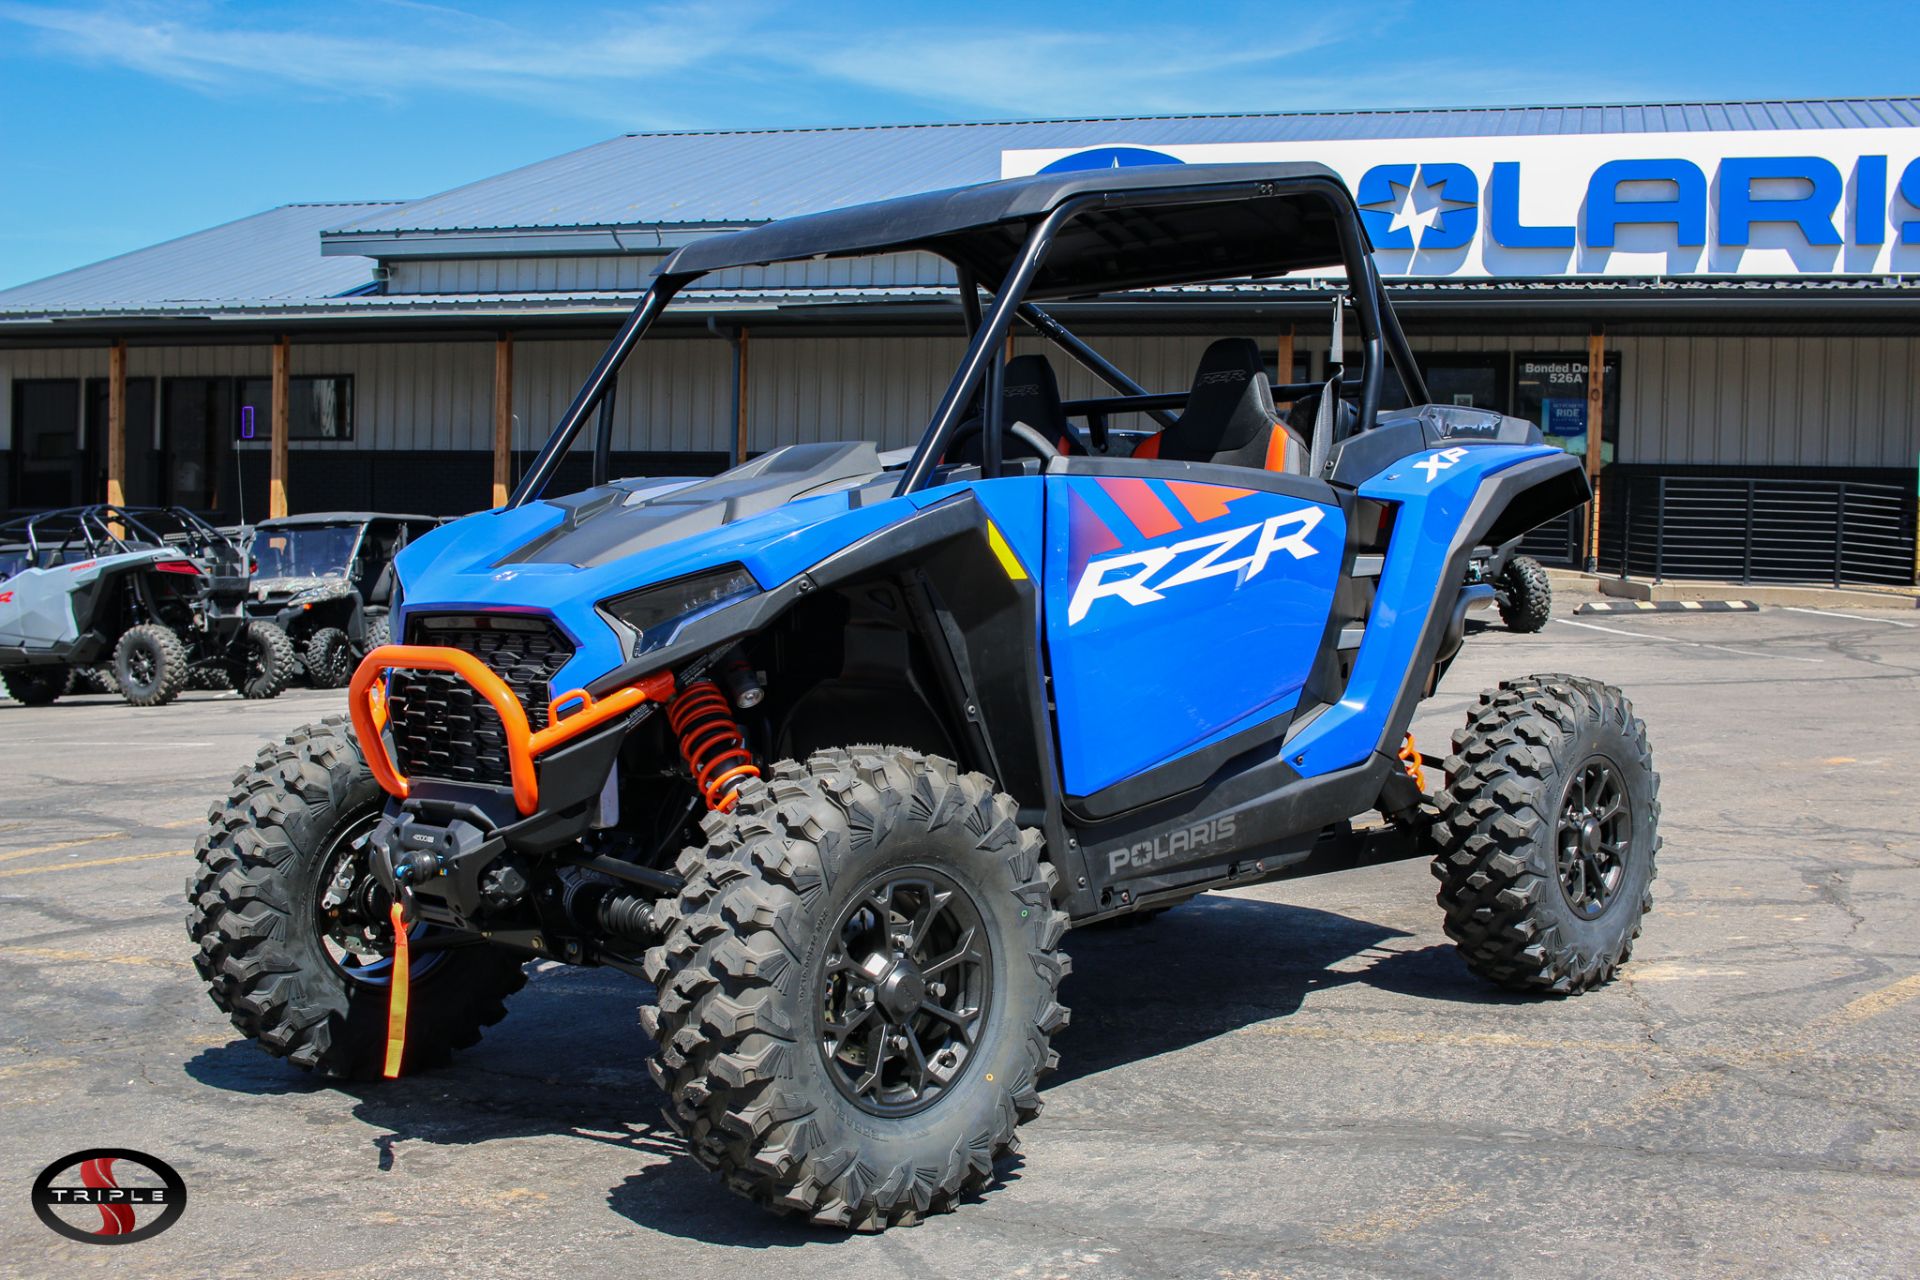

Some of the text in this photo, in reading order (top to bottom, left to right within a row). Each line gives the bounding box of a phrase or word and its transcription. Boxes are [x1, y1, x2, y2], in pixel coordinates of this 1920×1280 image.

[1357, 154, 1920, 250] OLARI
[1525, 363, 1569, 374] Bonded
[1549, 373, 1583, 384] 526A
[1556, 408, 1580, 418] RIDE
[1411, 447, 1469, 484] XP
[1068, 505, 1326, 626] RZR
[1108, 814, 1237, 876] POLARIS
